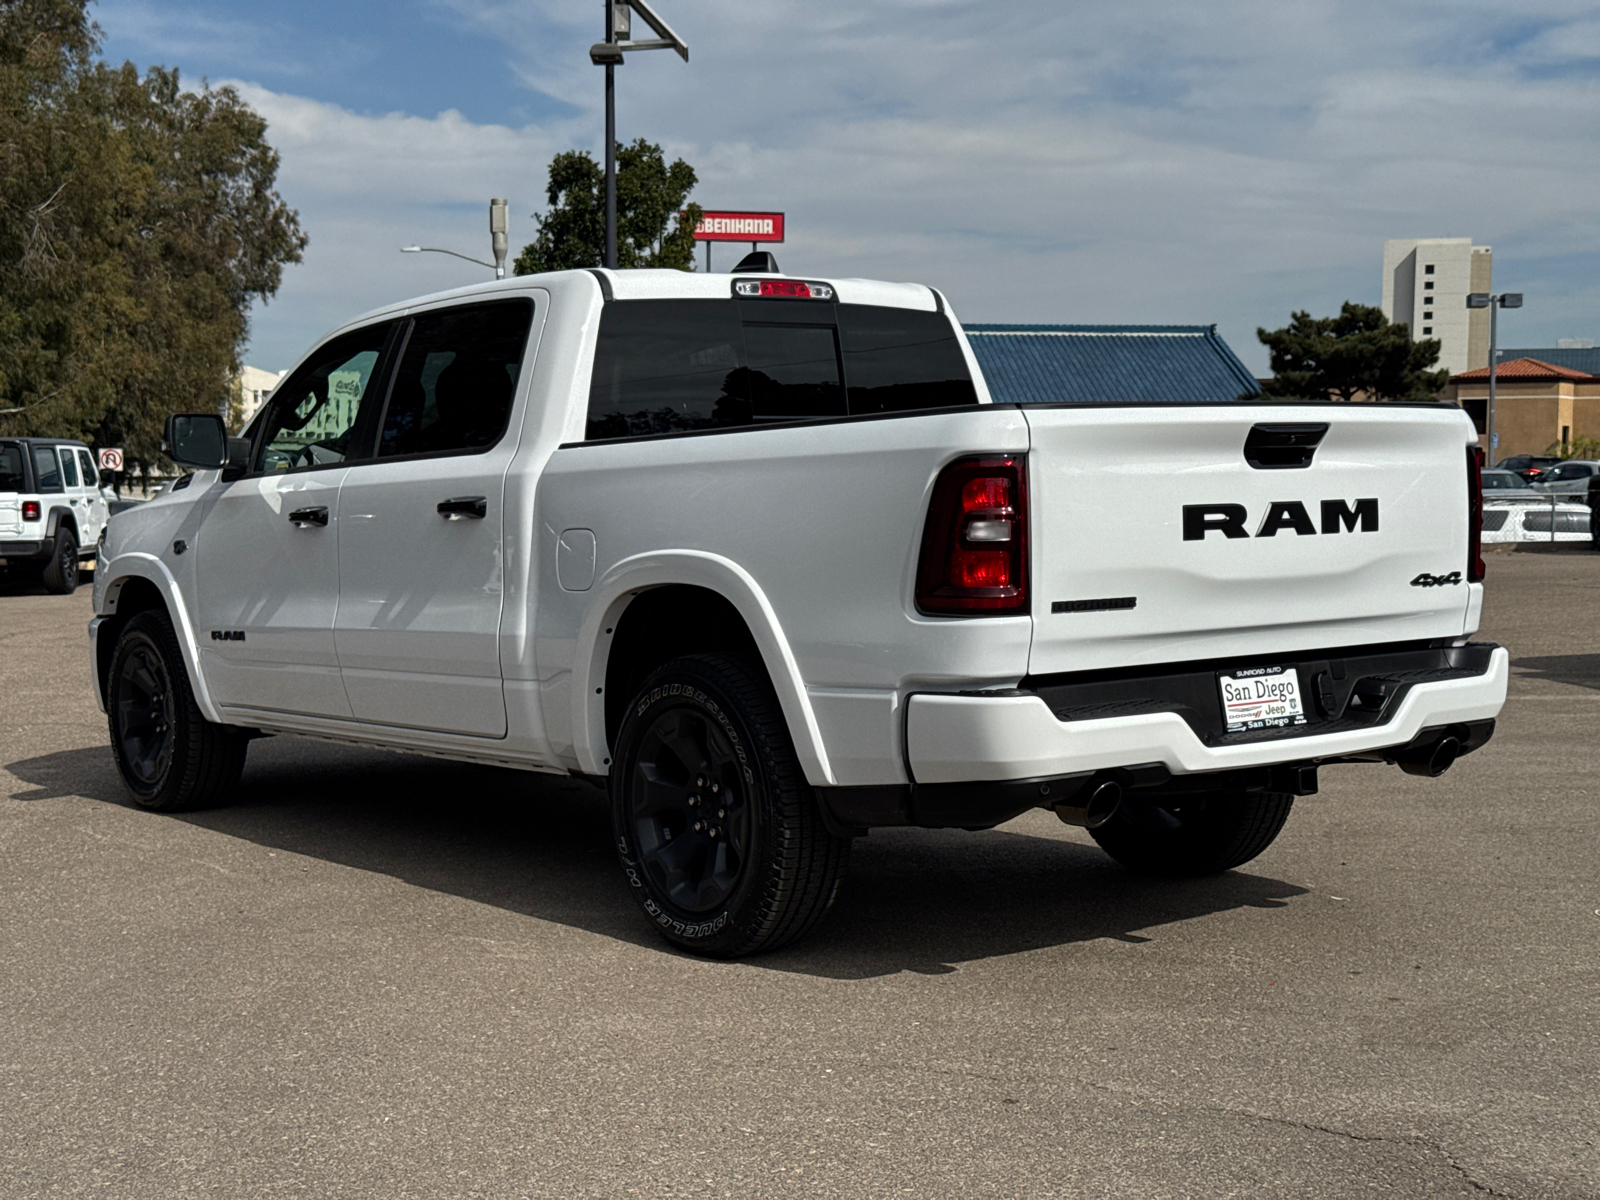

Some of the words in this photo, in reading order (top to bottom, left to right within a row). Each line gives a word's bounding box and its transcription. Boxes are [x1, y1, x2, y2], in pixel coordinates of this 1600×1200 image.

[704, 217, 773, 234] BENIHANA
[1182, 498, 1379, 541] RAM
[1409, 571, 1463, 588] 4x4
[211, 630, 246, 642] RAM
[1236, 668, 1265, 677] SUNROAD
[1266, 666, 1282, 674] AUTO
[1225, 683, 1252, 702] San
[1254, 678, 1294, 703] Diego
[1265, 704, 1286, 715] Jeep
[1248, 721, 1264, 729] San
[1265, 718, 1289, 727] Diego
[638, 683, 753, 784] BRIDGESTONE
[644, 899, 728, 937] DUELER
